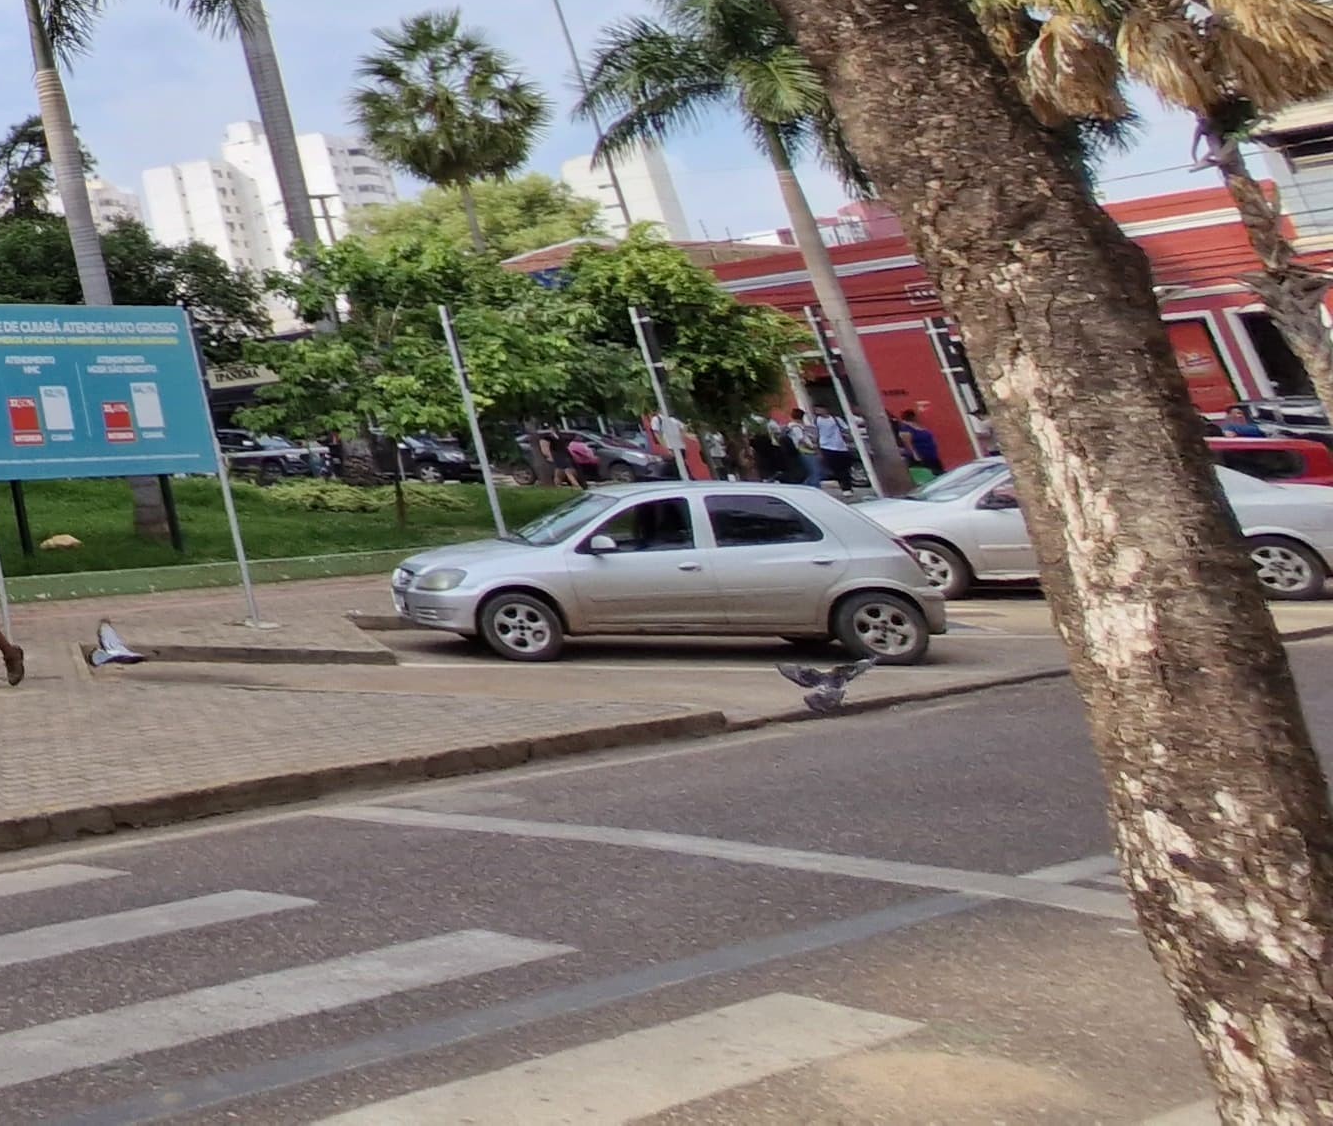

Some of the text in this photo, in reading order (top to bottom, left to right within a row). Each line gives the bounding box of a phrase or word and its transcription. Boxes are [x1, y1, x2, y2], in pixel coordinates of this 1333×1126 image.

[4, 320, 20, 333] DE
[20, 318, 61, 333] CUIABÁ
[62, 321, 104, 333] ATENDE
[105, 321, 134, 333] MATO
[135, 321, 179, 334] GROSSO
